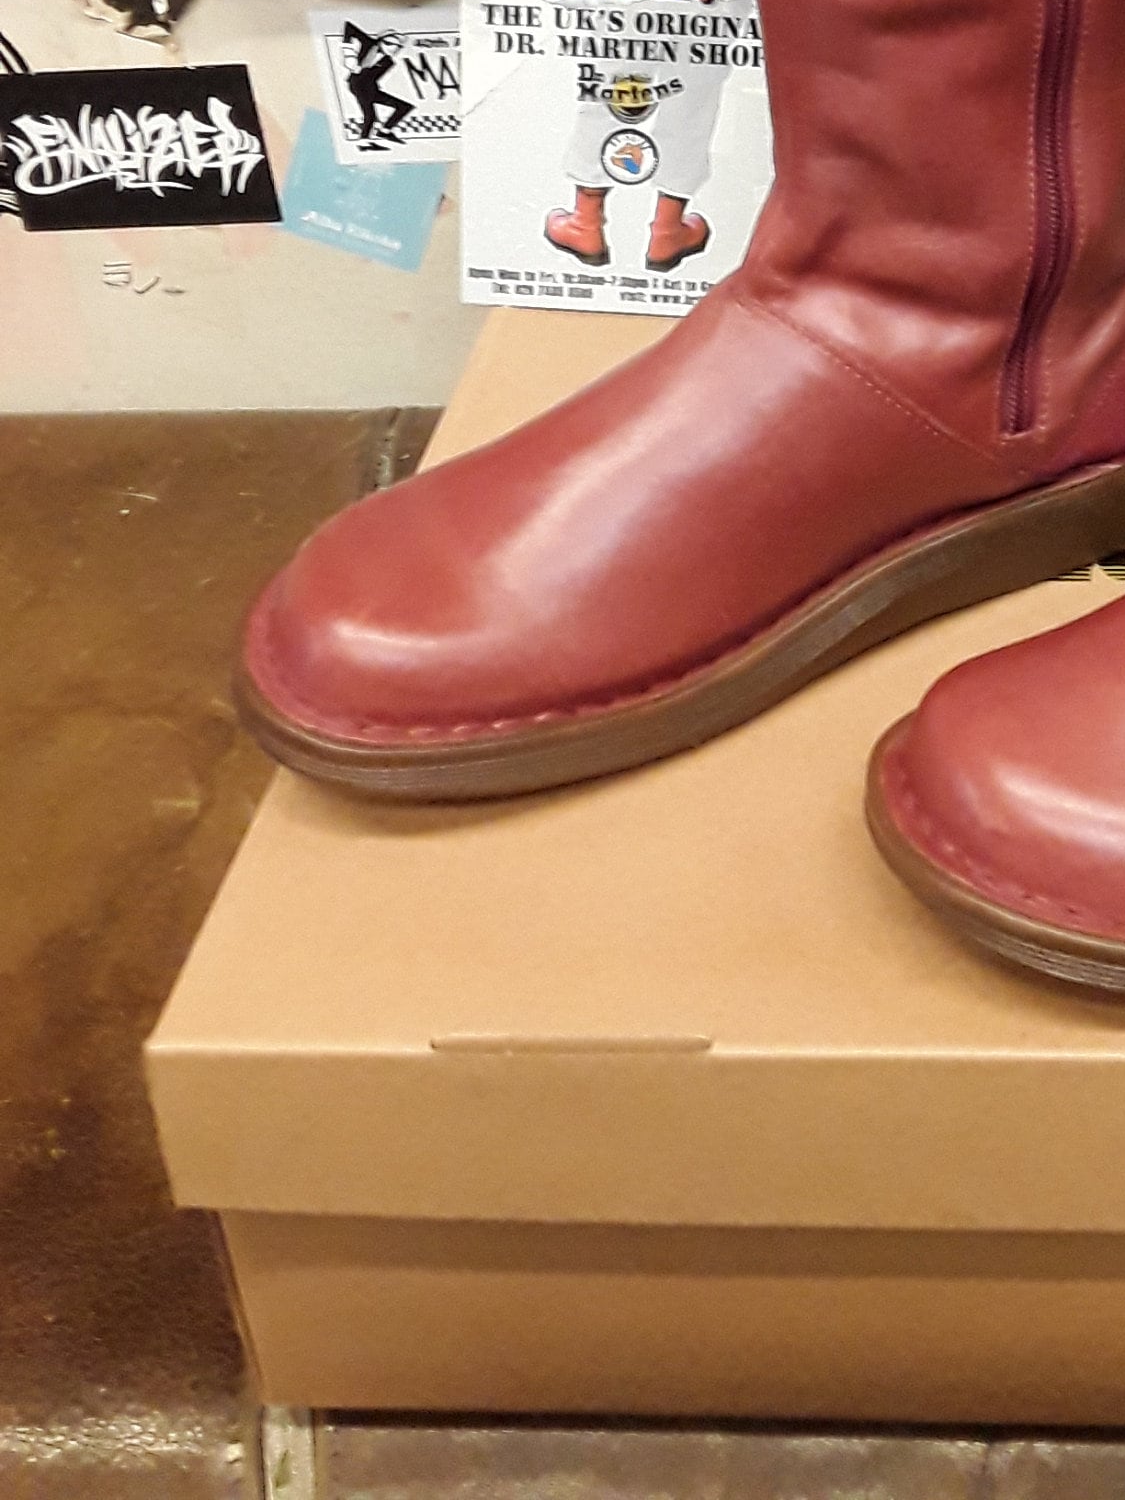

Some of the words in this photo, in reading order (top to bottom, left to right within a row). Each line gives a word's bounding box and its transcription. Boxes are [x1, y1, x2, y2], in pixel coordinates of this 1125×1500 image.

[481, 2, 542, 28] THE
[553, 7, 625, 33] UK'S
[635, 11, 763, 41] ORIGINA
[493, 31, 545, 56] DR.
[556, 34, 679, 63] MARTEN
